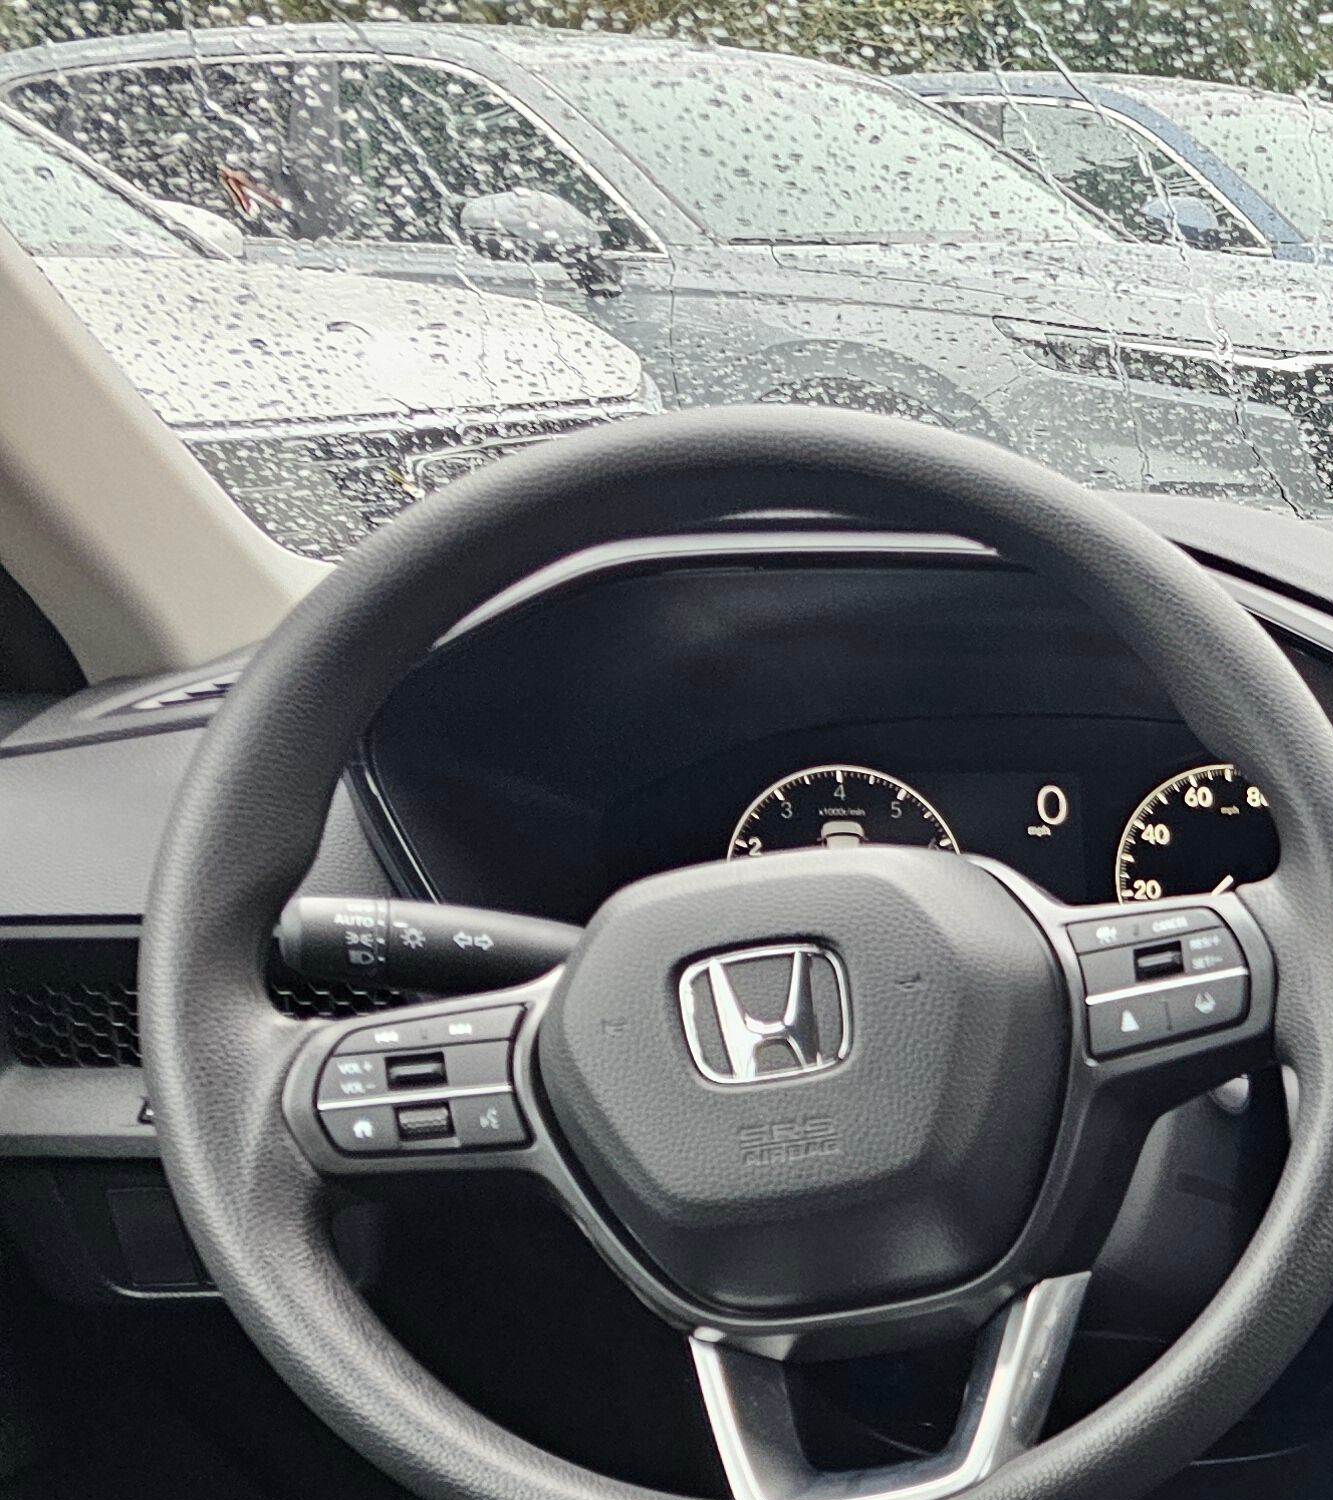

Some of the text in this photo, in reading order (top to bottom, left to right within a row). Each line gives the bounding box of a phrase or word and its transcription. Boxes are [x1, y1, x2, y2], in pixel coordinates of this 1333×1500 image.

[833, 784, 846, 801] 4
[1184, 786, 1213, 807] 60
[781, 801, 793, 819] 3
[891, 801, 902, 818] 5
[1037, 784, 1067, 825] 0
[1140, 823, 1171, 845] 40
[749, 836, 763, 856] 2
[1133, 879, 1161, 900] 20
[333, 913, 375, 928] AUTO
